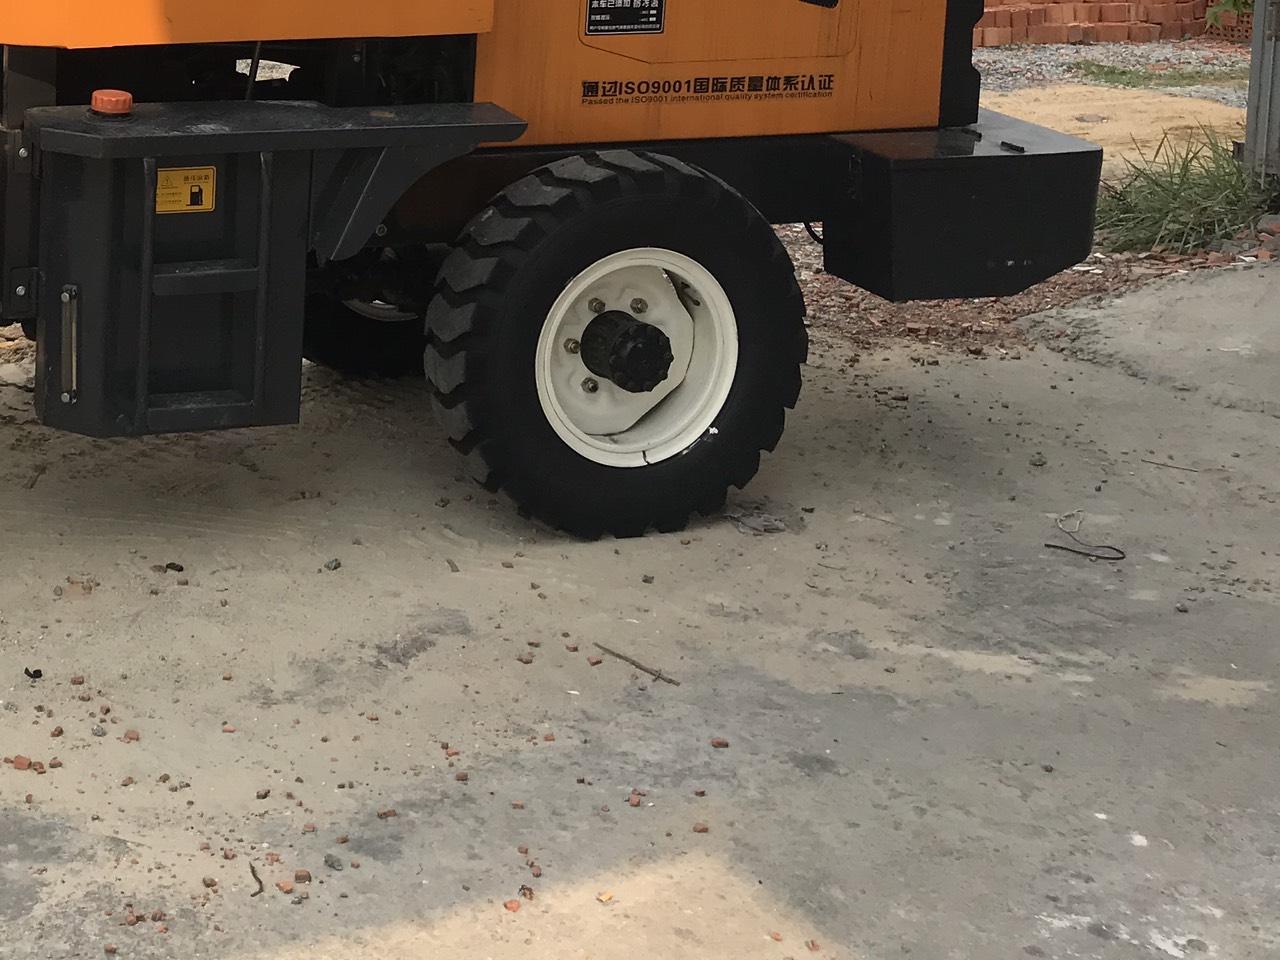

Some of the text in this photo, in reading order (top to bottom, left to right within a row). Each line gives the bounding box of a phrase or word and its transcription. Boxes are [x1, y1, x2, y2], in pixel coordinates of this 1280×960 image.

[582, 97, 614, 106] Passed
[616, 96, 629, 104] the
[631, 95, 668, 104] ISO9001
[724, 92, 752, 102] quality
[753, 91, 784, 101] system
